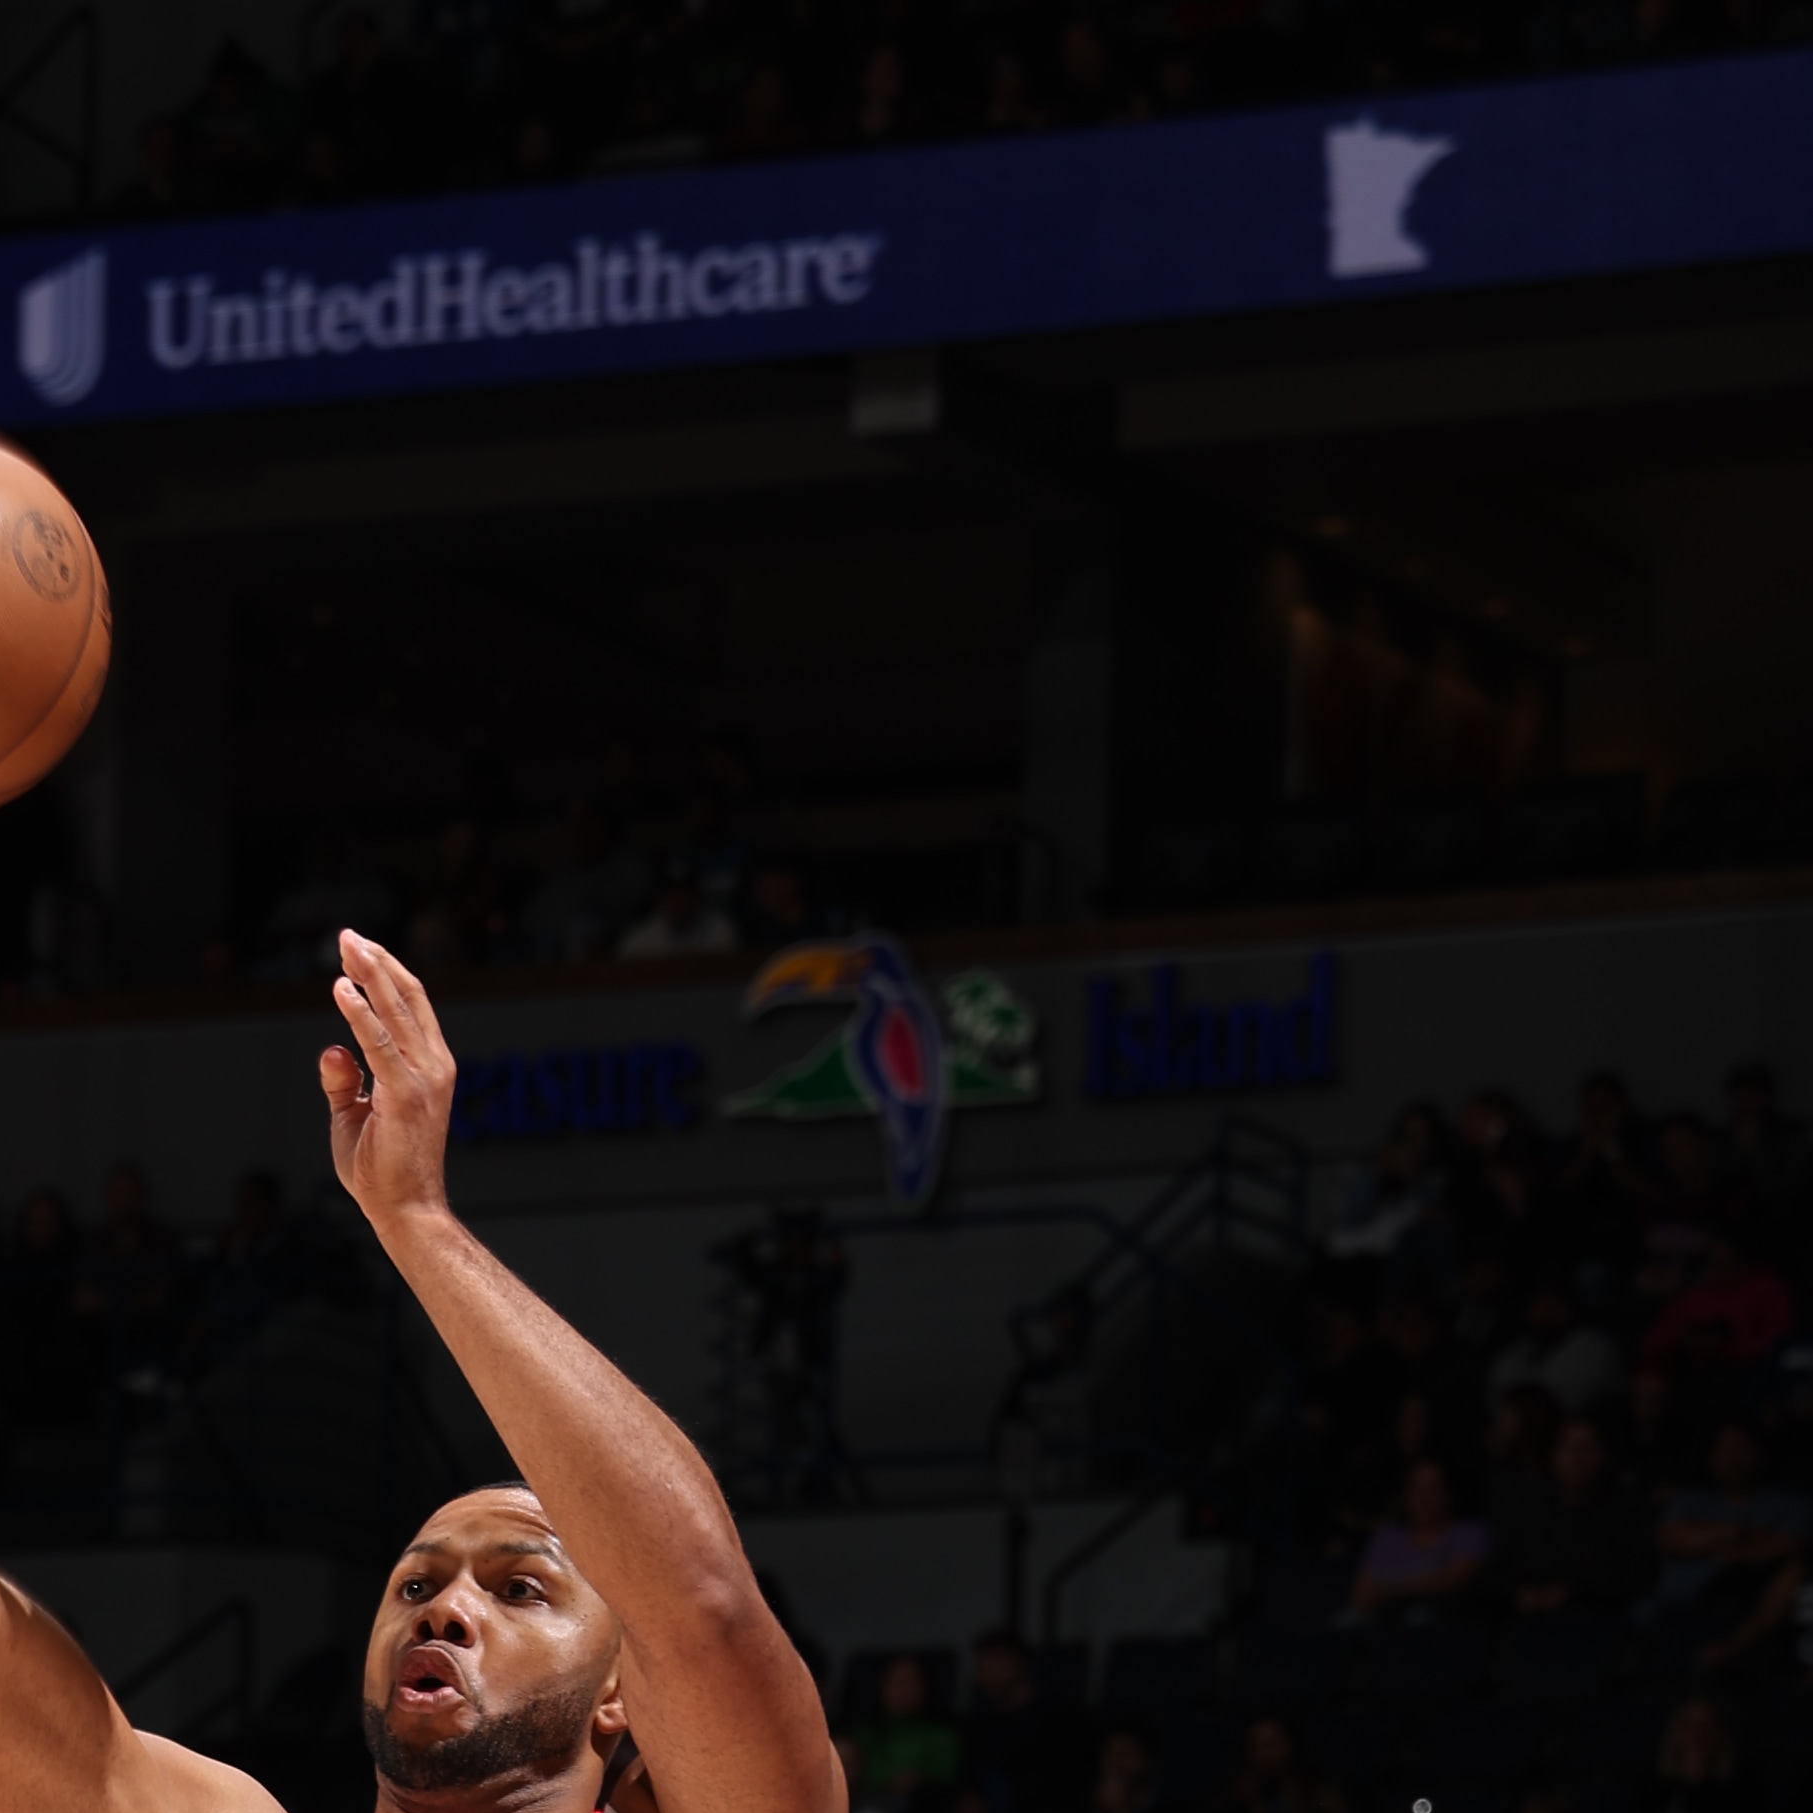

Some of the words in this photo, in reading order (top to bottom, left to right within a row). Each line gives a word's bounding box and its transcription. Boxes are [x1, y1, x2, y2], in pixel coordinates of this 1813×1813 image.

[144, 229, 880, 371] UnitedHealthcare
[450, 1040, 701, 1143] easure
[1084, 952, 1336, 1101] Island
